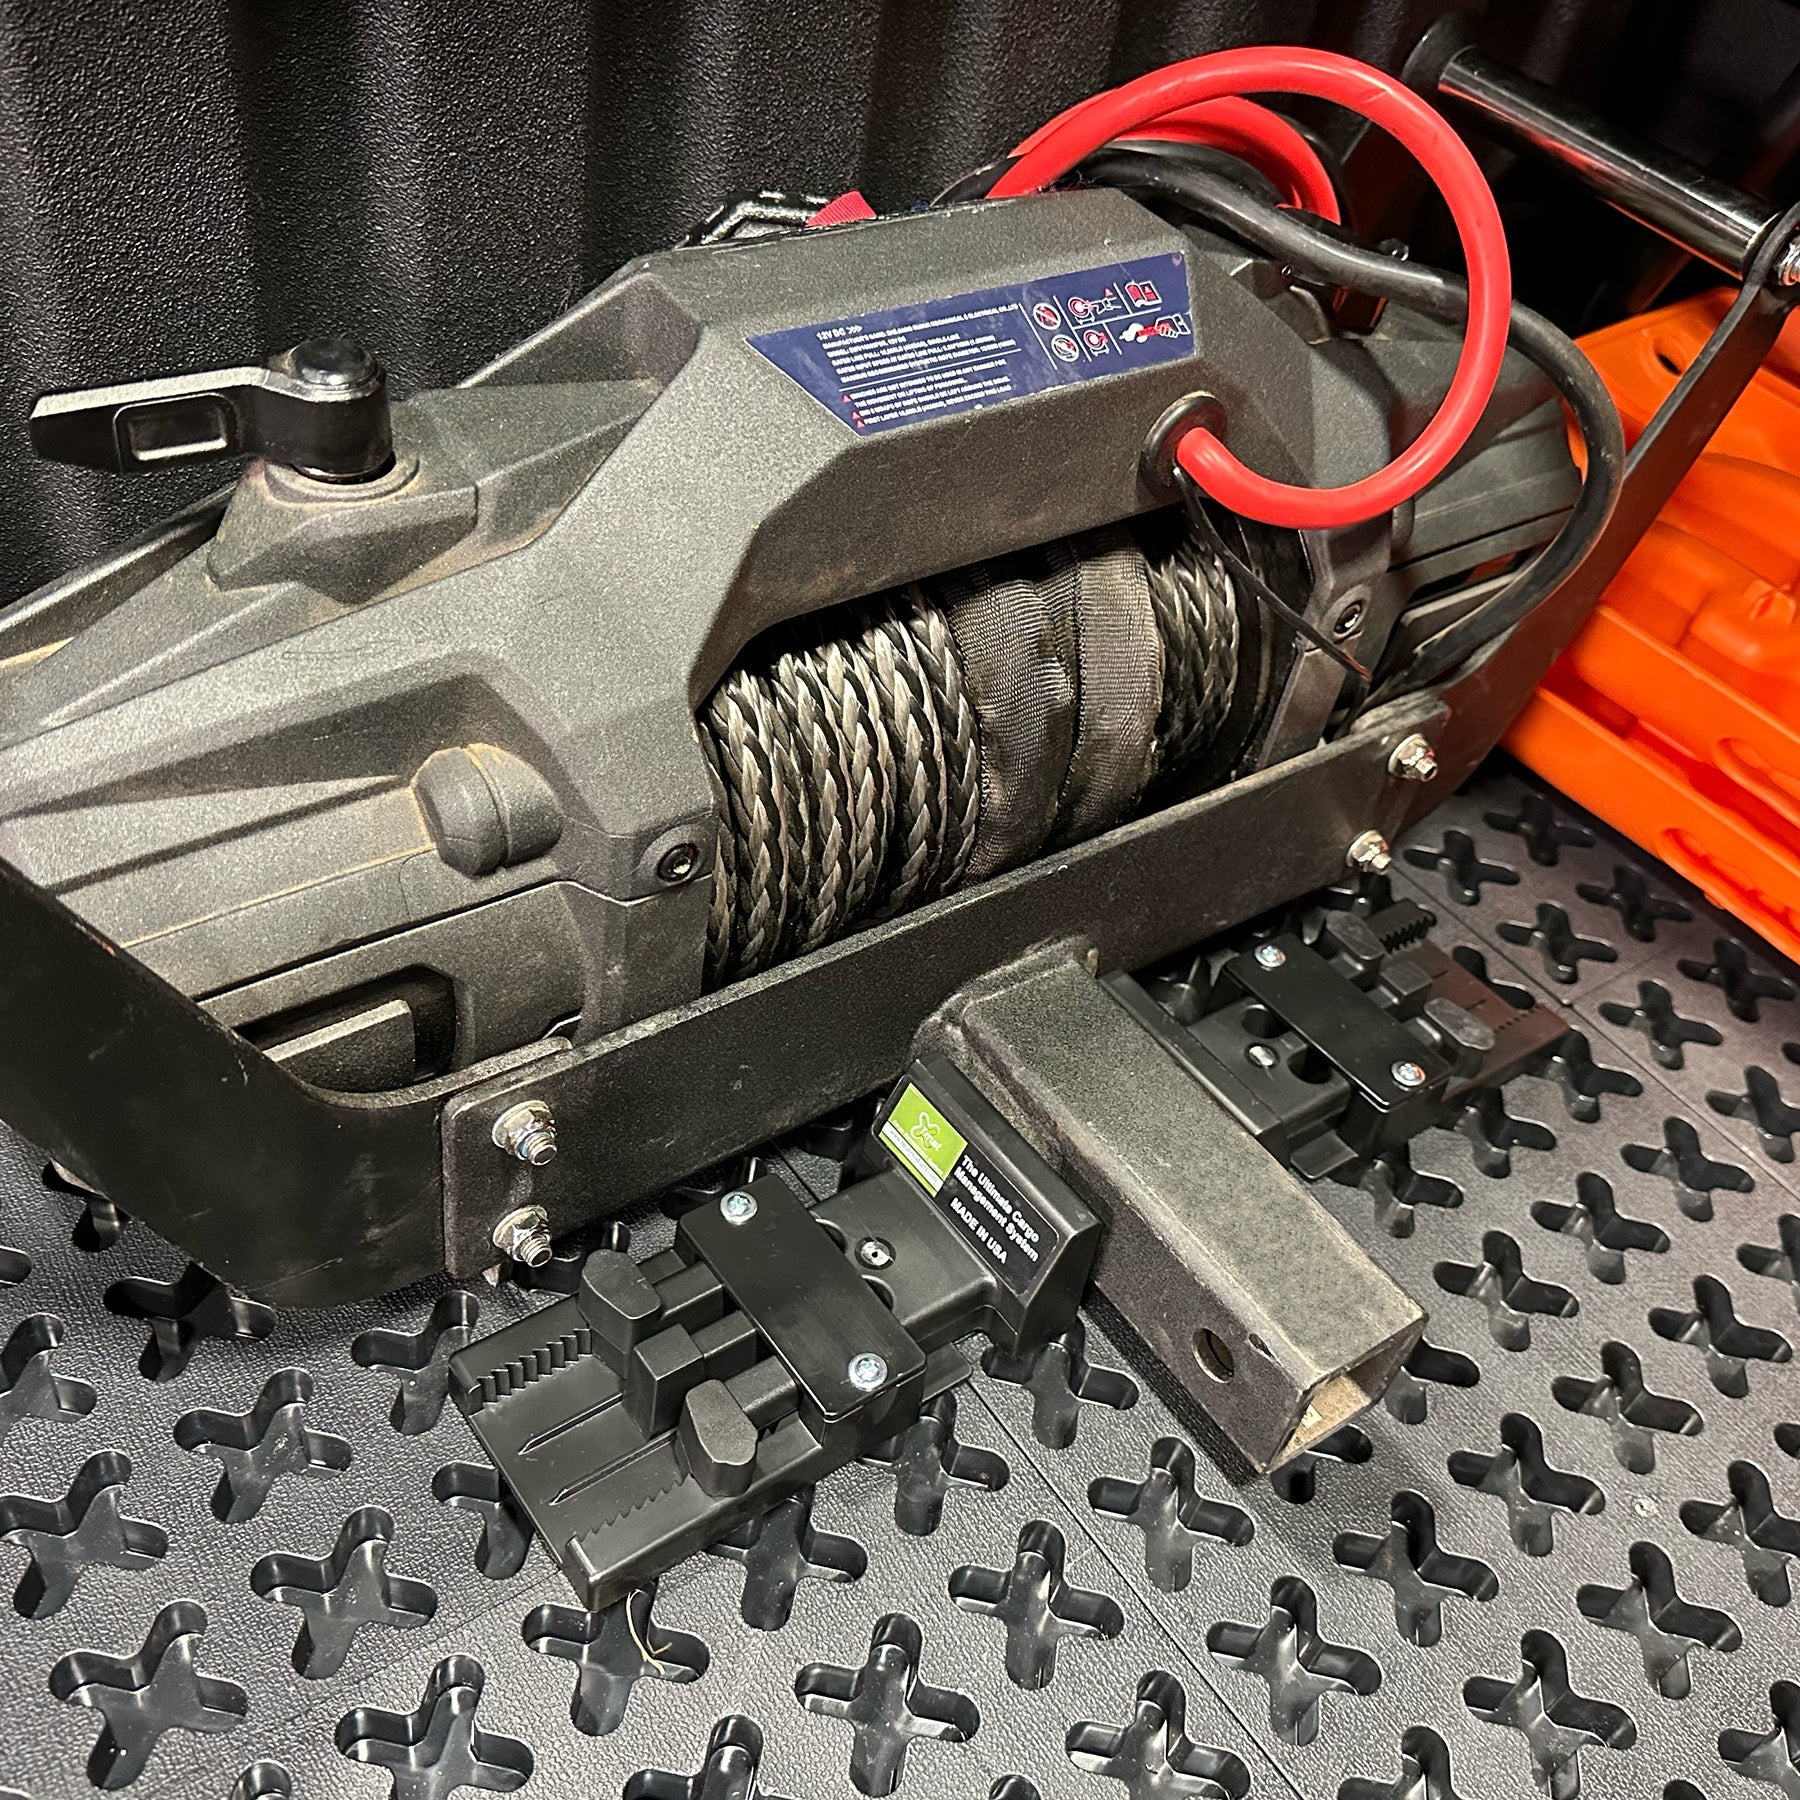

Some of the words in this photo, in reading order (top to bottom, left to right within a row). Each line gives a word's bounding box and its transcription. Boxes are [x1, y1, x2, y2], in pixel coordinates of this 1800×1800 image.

[817, 330, 832, 340] 12V
[832, 328, 845, 337] DC
[950, 1198, 978, 1230] MADE
[976, 1225, 989, 1241] IN
[986, 1237, 1006, 1263] USA
[953, 1166, 1007, 1227] Management
[1005, 1223, 1038, 1261] System
[962, 1155, 978, 1177] The
[978, 1173, 1012, 1214] Ultimate
[1012, 1211, 1038, 1242] Cargo
